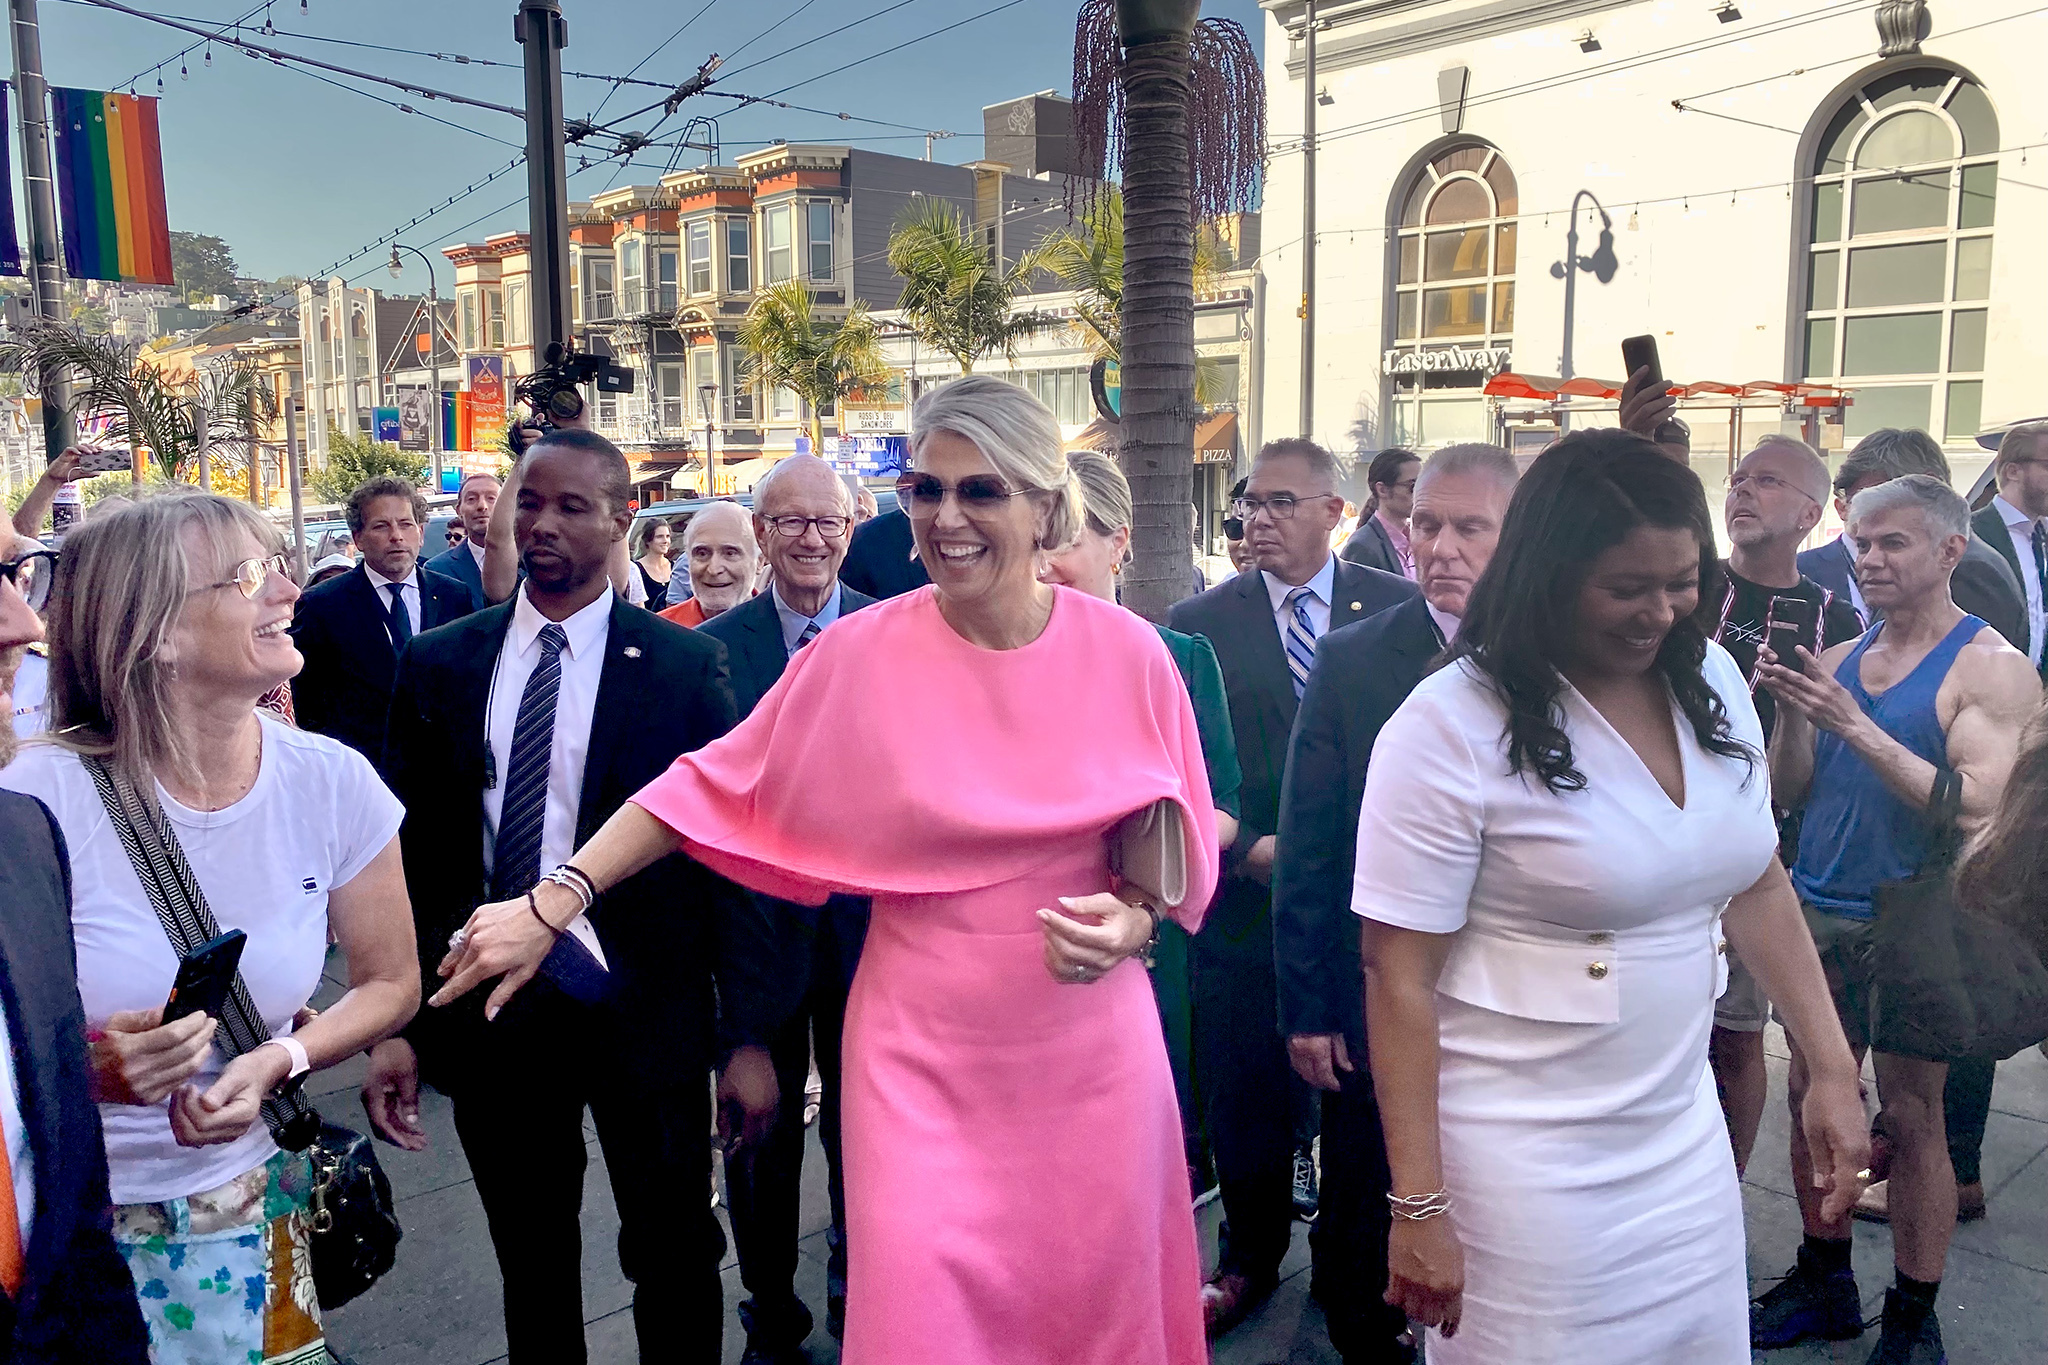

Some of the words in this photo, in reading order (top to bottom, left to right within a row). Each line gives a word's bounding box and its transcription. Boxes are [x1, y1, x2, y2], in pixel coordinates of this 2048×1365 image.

[1383, 345, 1507, 375] LaserAway
[1105, 372, 1120, 384] MA
[858, 412, 880, 420] ROSSI'S
[883, 412, 894, 420] DELI
[860, 420, 893, 428] SANDWICHES
[1203, 449, 1233, 462] PIZZA
